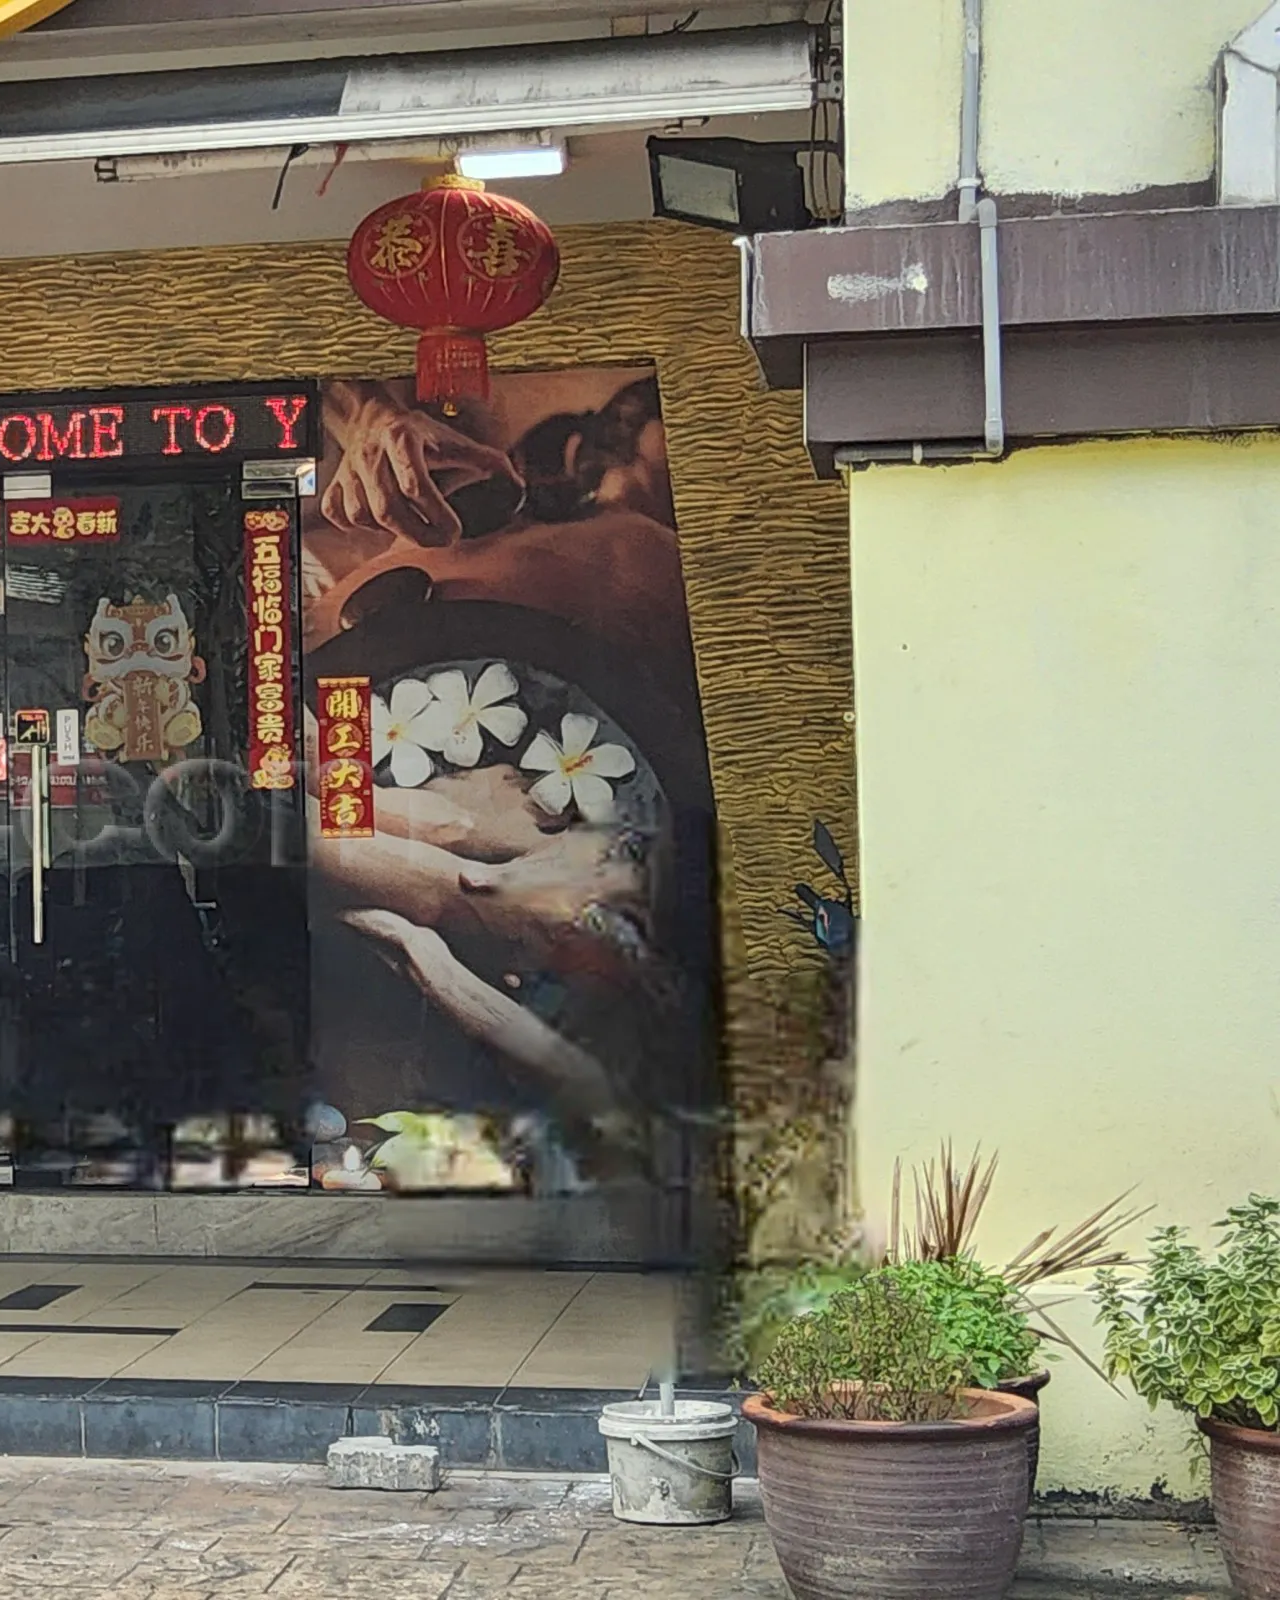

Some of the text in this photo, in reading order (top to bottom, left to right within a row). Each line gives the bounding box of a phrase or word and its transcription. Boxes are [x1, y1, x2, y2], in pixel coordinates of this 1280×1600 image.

[153, 404, 236, 453] TO
[265, 395, 307, 449] Y
[63, 715, 73, 752] PUSH
[327, 687, 364, 827] 開工大吉
